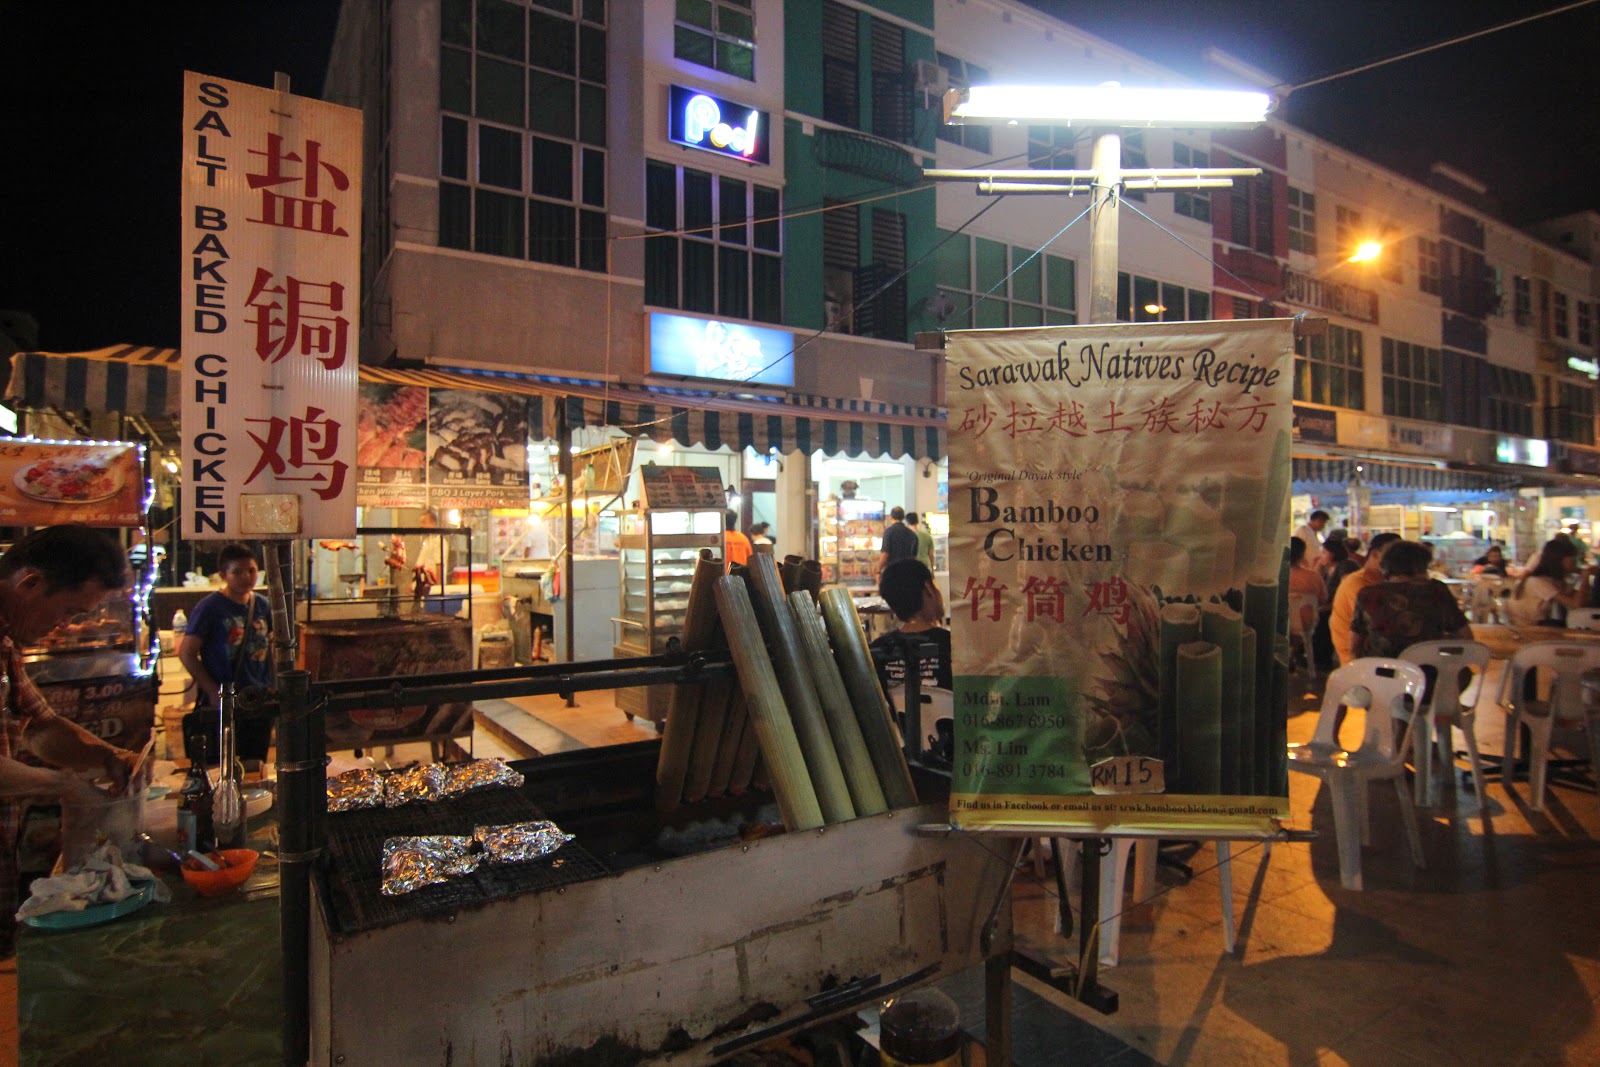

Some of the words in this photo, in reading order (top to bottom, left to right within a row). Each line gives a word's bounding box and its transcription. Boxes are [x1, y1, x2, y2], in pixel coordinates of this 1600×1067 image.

[193, 82, 231, 187] SALT
[192, 205, 230, 334] BAKED
[959, 340, 1082, 391] Sarawak
[1081, 341, 1185, 382] Natives
[1193, 348, 1281, 394] Recipe
[956, 396, 1277, 440] 砂拉越土族秘方
[193, 354, 228, 534] CHICKEN
[1018, 470, 1054, 483] Dayak
[431, 489, 451, 497] BBQ
[453, 489, 458, 497] 3
[460, 490, 484, 499] Layer
[485, 490, 505, 498] Pork
[967, 487, 1099, 523] Bamboo
[984, 528, 1112, 561] Chicken
[963, 576, 1131, 625] 竹筒鸡
[84, 683, 124, 701] 3.00
[1015, 692, 1051, 707] Lam
[1029, 715, 1066, 729] 6950
[997, 741, 1029, 755] Lim
[963, 762, 1021, 778] 016-891
[1029, 764, 1066, 779] 3784
[956, 799, 978, 809] Find
[980, 801, 991, 810] us
[993, 799, 1002, 809] in
[1004, 800, 1048, 811] Facebook
[1063, 802, 1089, 811] email
[1092, 803, 1102, 812] us
